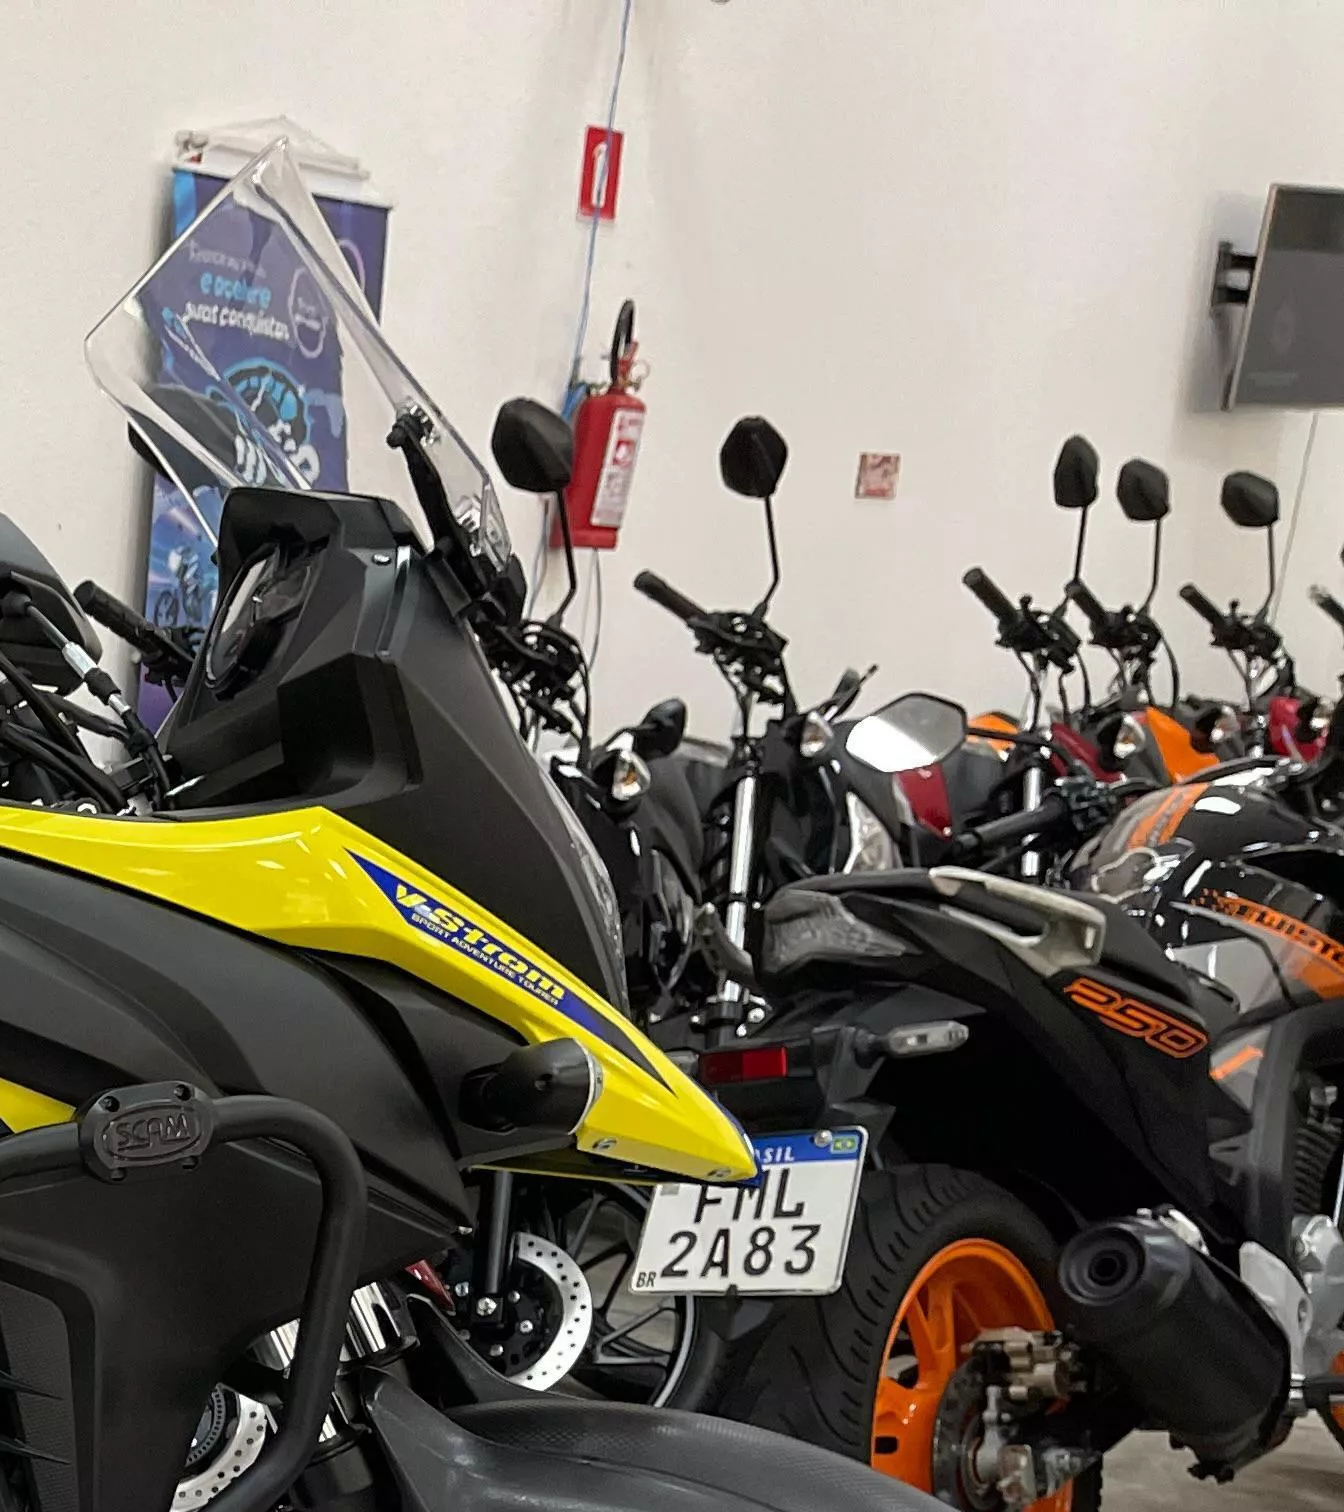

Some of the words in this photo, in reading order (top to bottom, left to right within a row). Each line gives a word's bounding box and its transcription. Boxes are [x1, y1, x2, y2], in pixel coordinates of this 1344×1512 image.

[411, 912, 451, 939] SPORT
[450, 935, 517, 980] ADVENTURE
[660, 1224, 822, 1279] 2A83
[636, 1271, 658, 1289] BR
